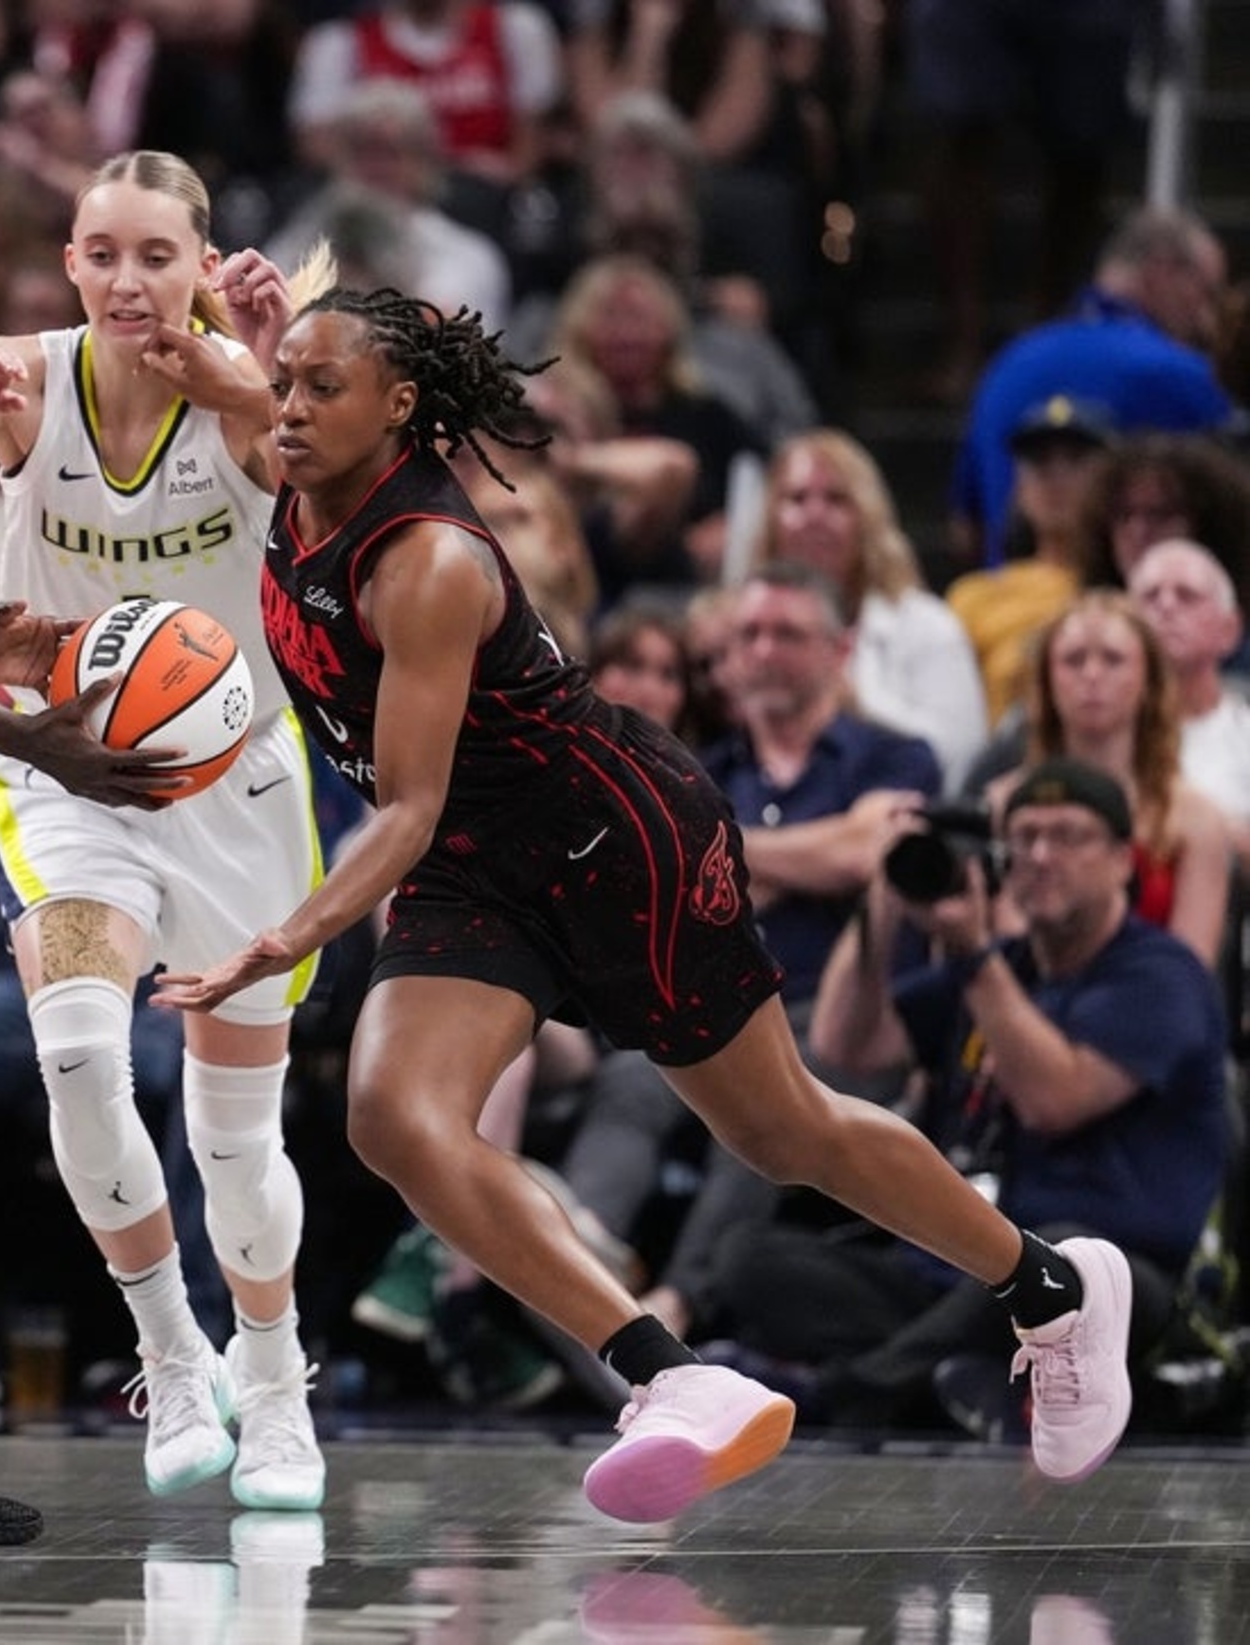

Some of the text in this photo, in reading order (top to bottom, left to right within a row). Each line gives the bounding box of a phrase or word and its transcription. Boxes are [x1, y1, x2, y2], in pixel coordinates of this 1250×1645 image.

[167, 477, 214, 497] Albert
[40, 507, 233, 563] WINGS
[303, 585, 344, 619] Lilly
